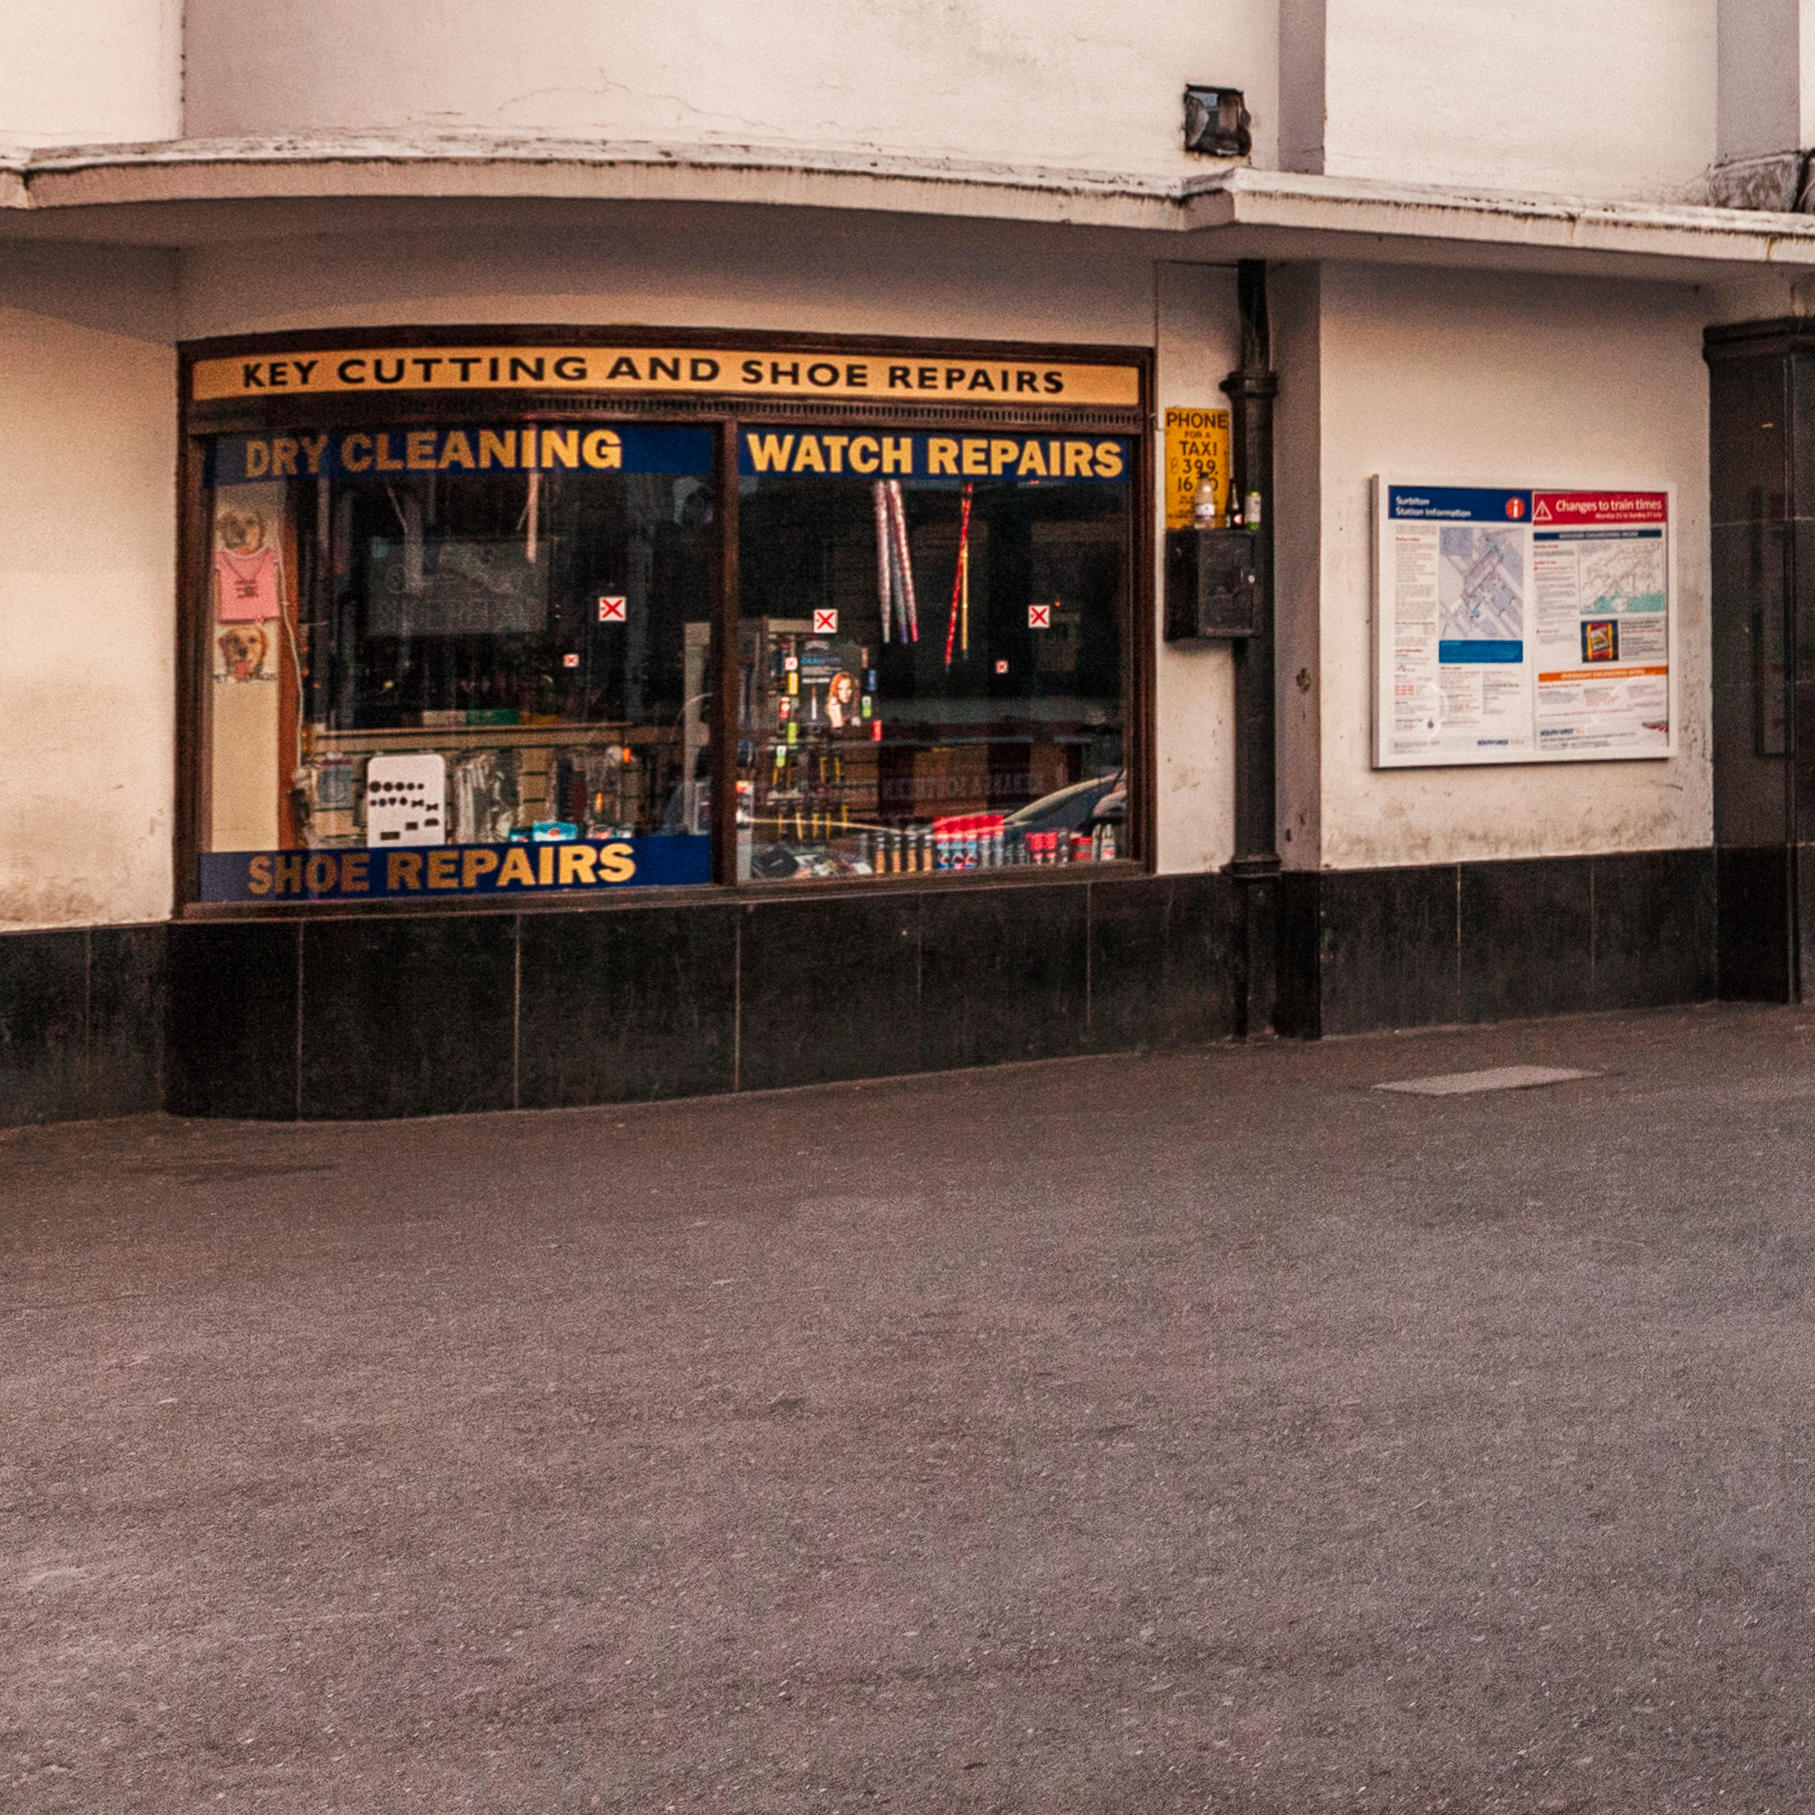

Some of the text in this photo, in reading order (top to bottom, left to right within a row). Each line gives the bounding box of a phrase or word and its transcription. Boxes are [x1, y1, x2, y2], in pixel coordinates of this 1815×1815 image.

[243, 356, 1066, 394] KEY CUTTING AND SHOE REPAIRS
[1166, 412, 1228, 429] PHONE
[245, 430, 623, 478] DRY CLEANING
[747, 433, 1124, 478] WATCH REPAIRS
[1179, 441, 1218, 456] TAXI
[1177, 477, 1219, 493] 160
[1395, 495, 1430, 506] Surbiton
[1555, 499, 1662, 514] Changes to train times
[1395, 507, 1424, 517] Station
[247, 843, 637, 896] SHOE REPAIRS
